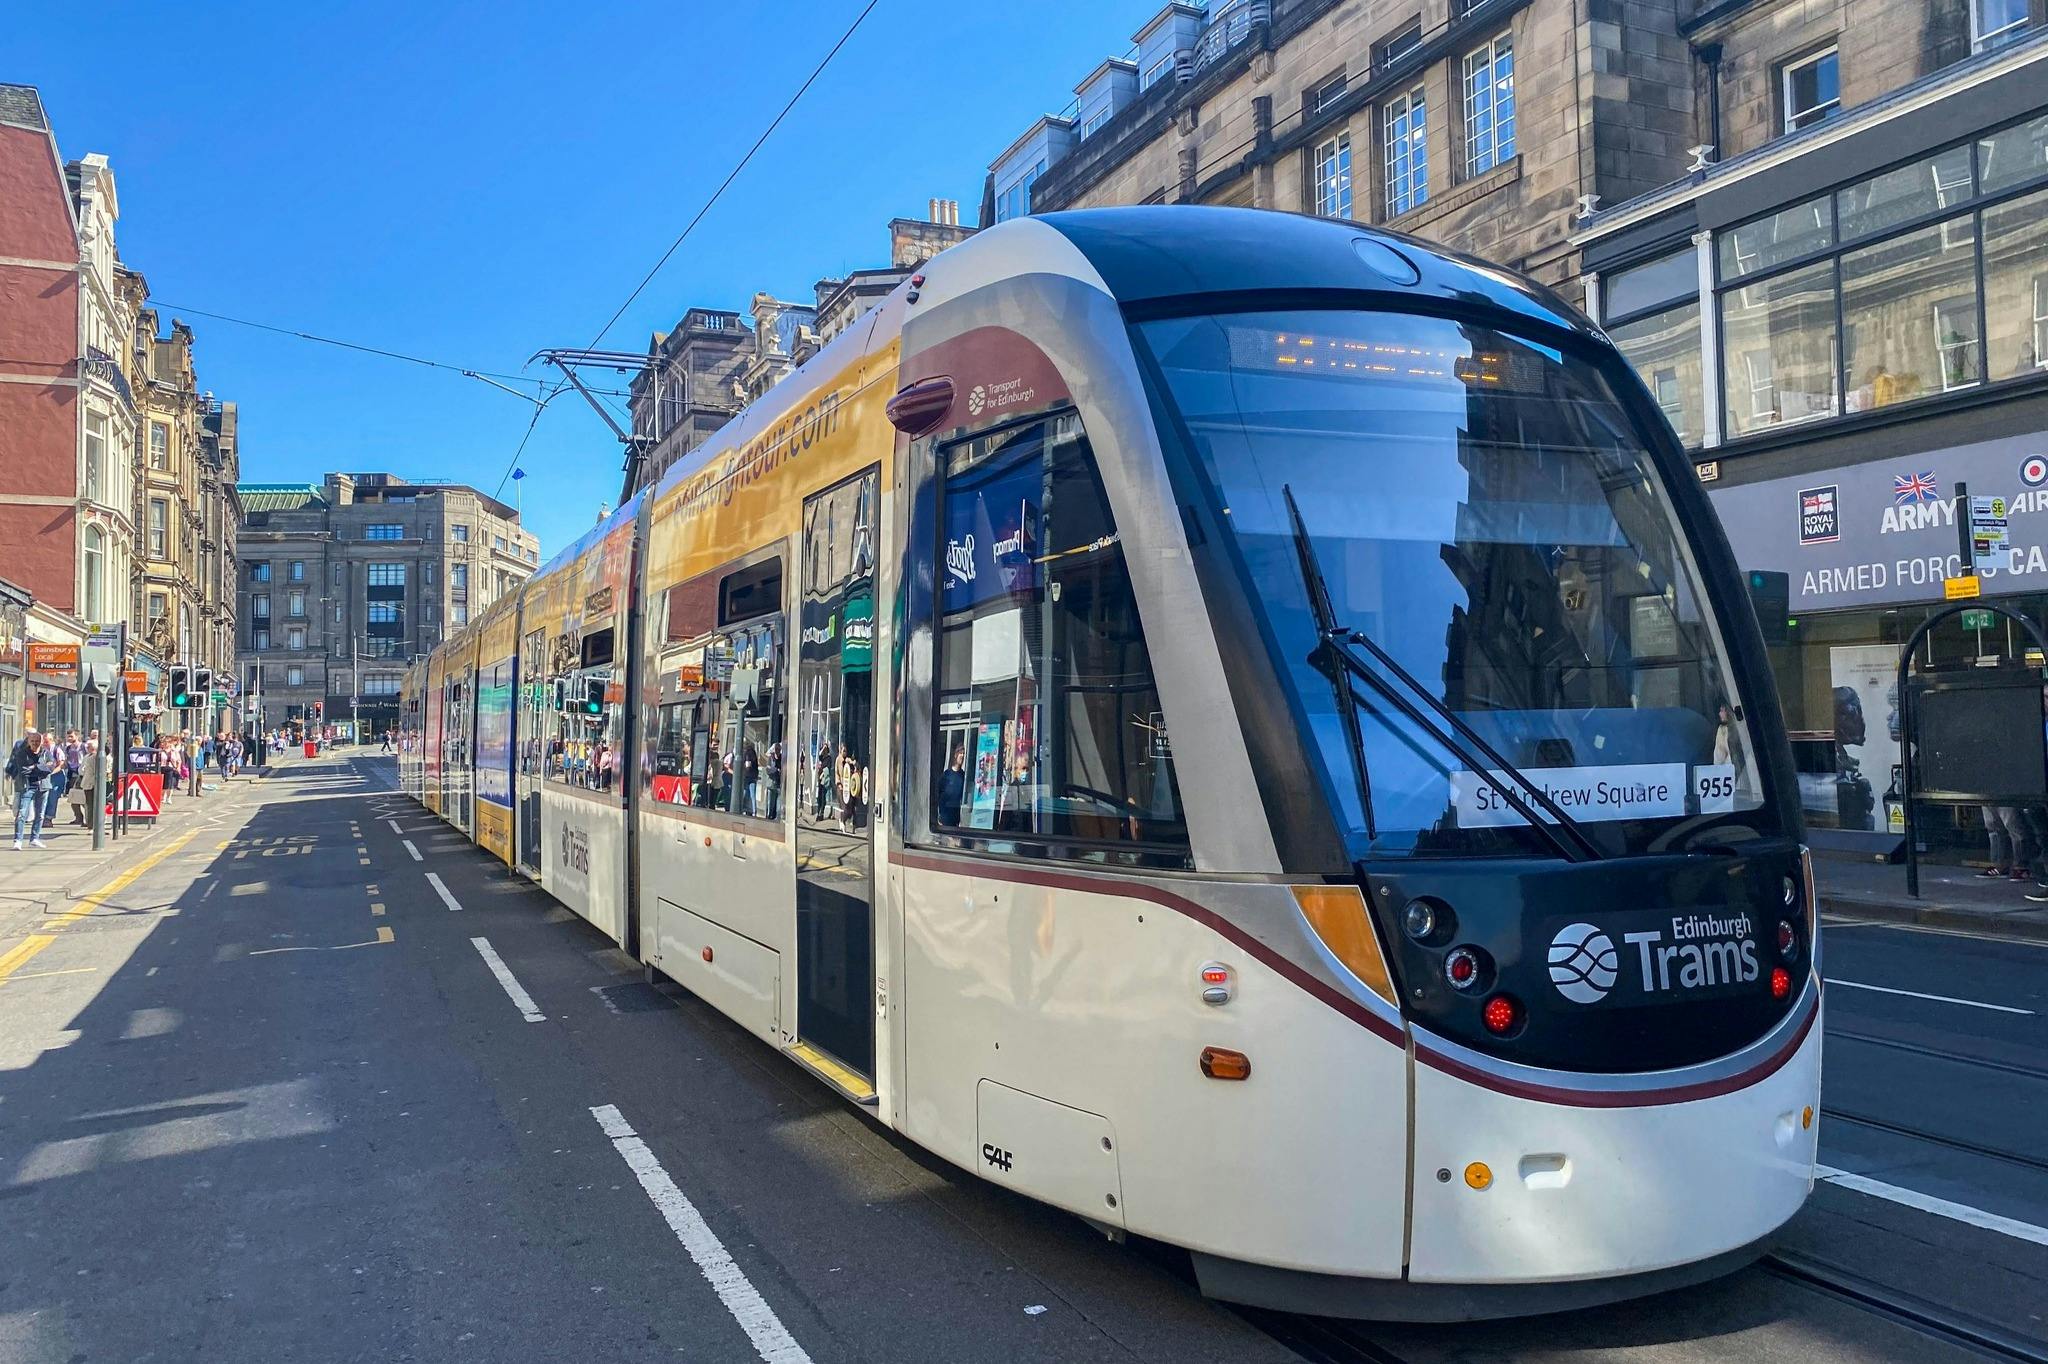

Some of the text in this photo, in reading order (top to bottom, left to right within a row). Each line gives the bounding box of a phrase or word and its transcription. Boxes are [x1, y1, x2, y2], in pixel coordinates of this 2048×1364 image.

[987, 387, 1034, 409] for Edinburgh
[988, 378, 1021, 394] Transport
[1881, 498, 1957, 533] ARMY
[1992, 502, 2003, 513] SE
[1804, 514, 1834, 526] ROYAL
[1804, 522, 1834, 536] NAVY
[1802, 562, 1886, 595] ARMED
[1476, 787, 1499, 810] St
[1597, 781, 1669, 808] Square
[1700, 777, 1733, 799] 955
[1672, 912, 1752, 939] Edinburgh
[1624, 931, 1759, 992] Trams
[983, 1143, 1012, 1172] CAF
